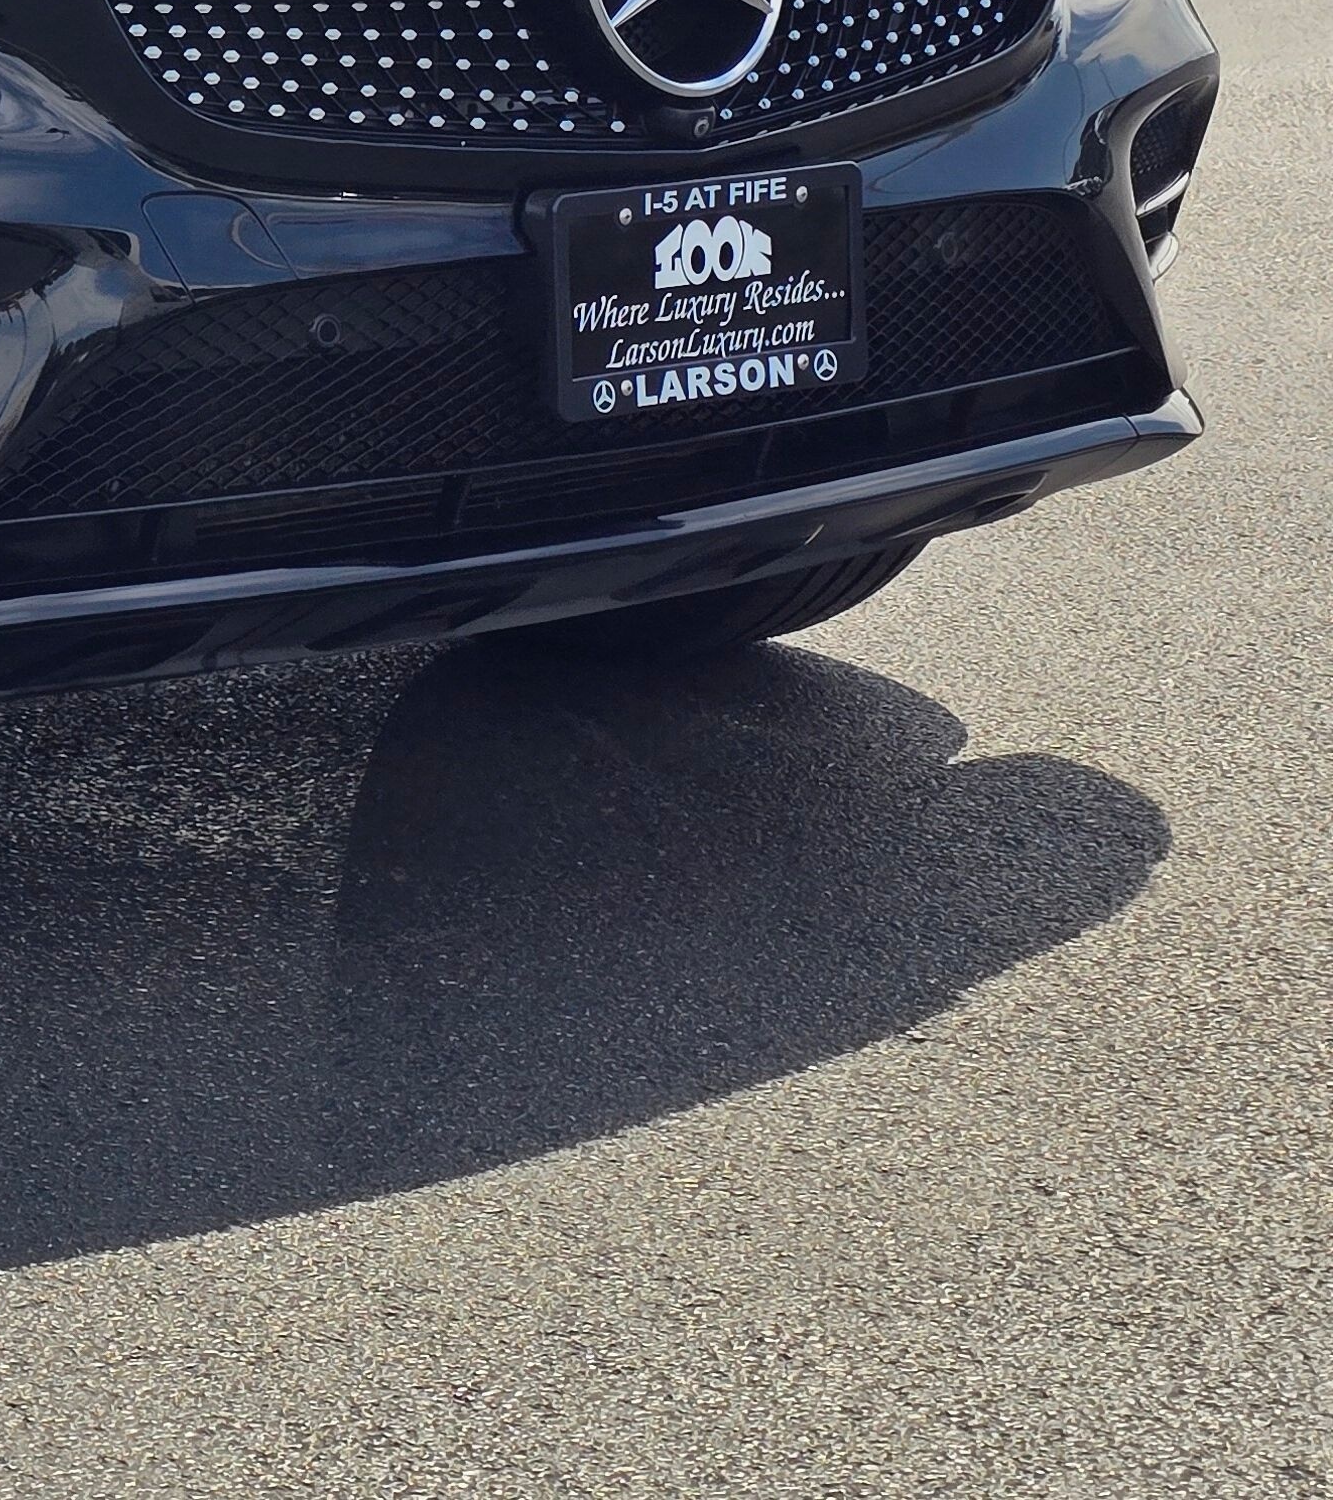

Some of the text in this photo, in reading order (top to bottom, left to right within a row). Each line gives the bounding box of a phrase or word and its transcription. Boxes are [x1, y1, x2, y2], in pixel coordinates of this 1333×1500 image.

[644, 177, 787, 215] I-5 AT FIFE
[573, 269, 845, 333] Where Luxury Resides...
[605, 319, 815, 369] LarsonLuxury.com
[636, 354, 795, 407] LARSON
